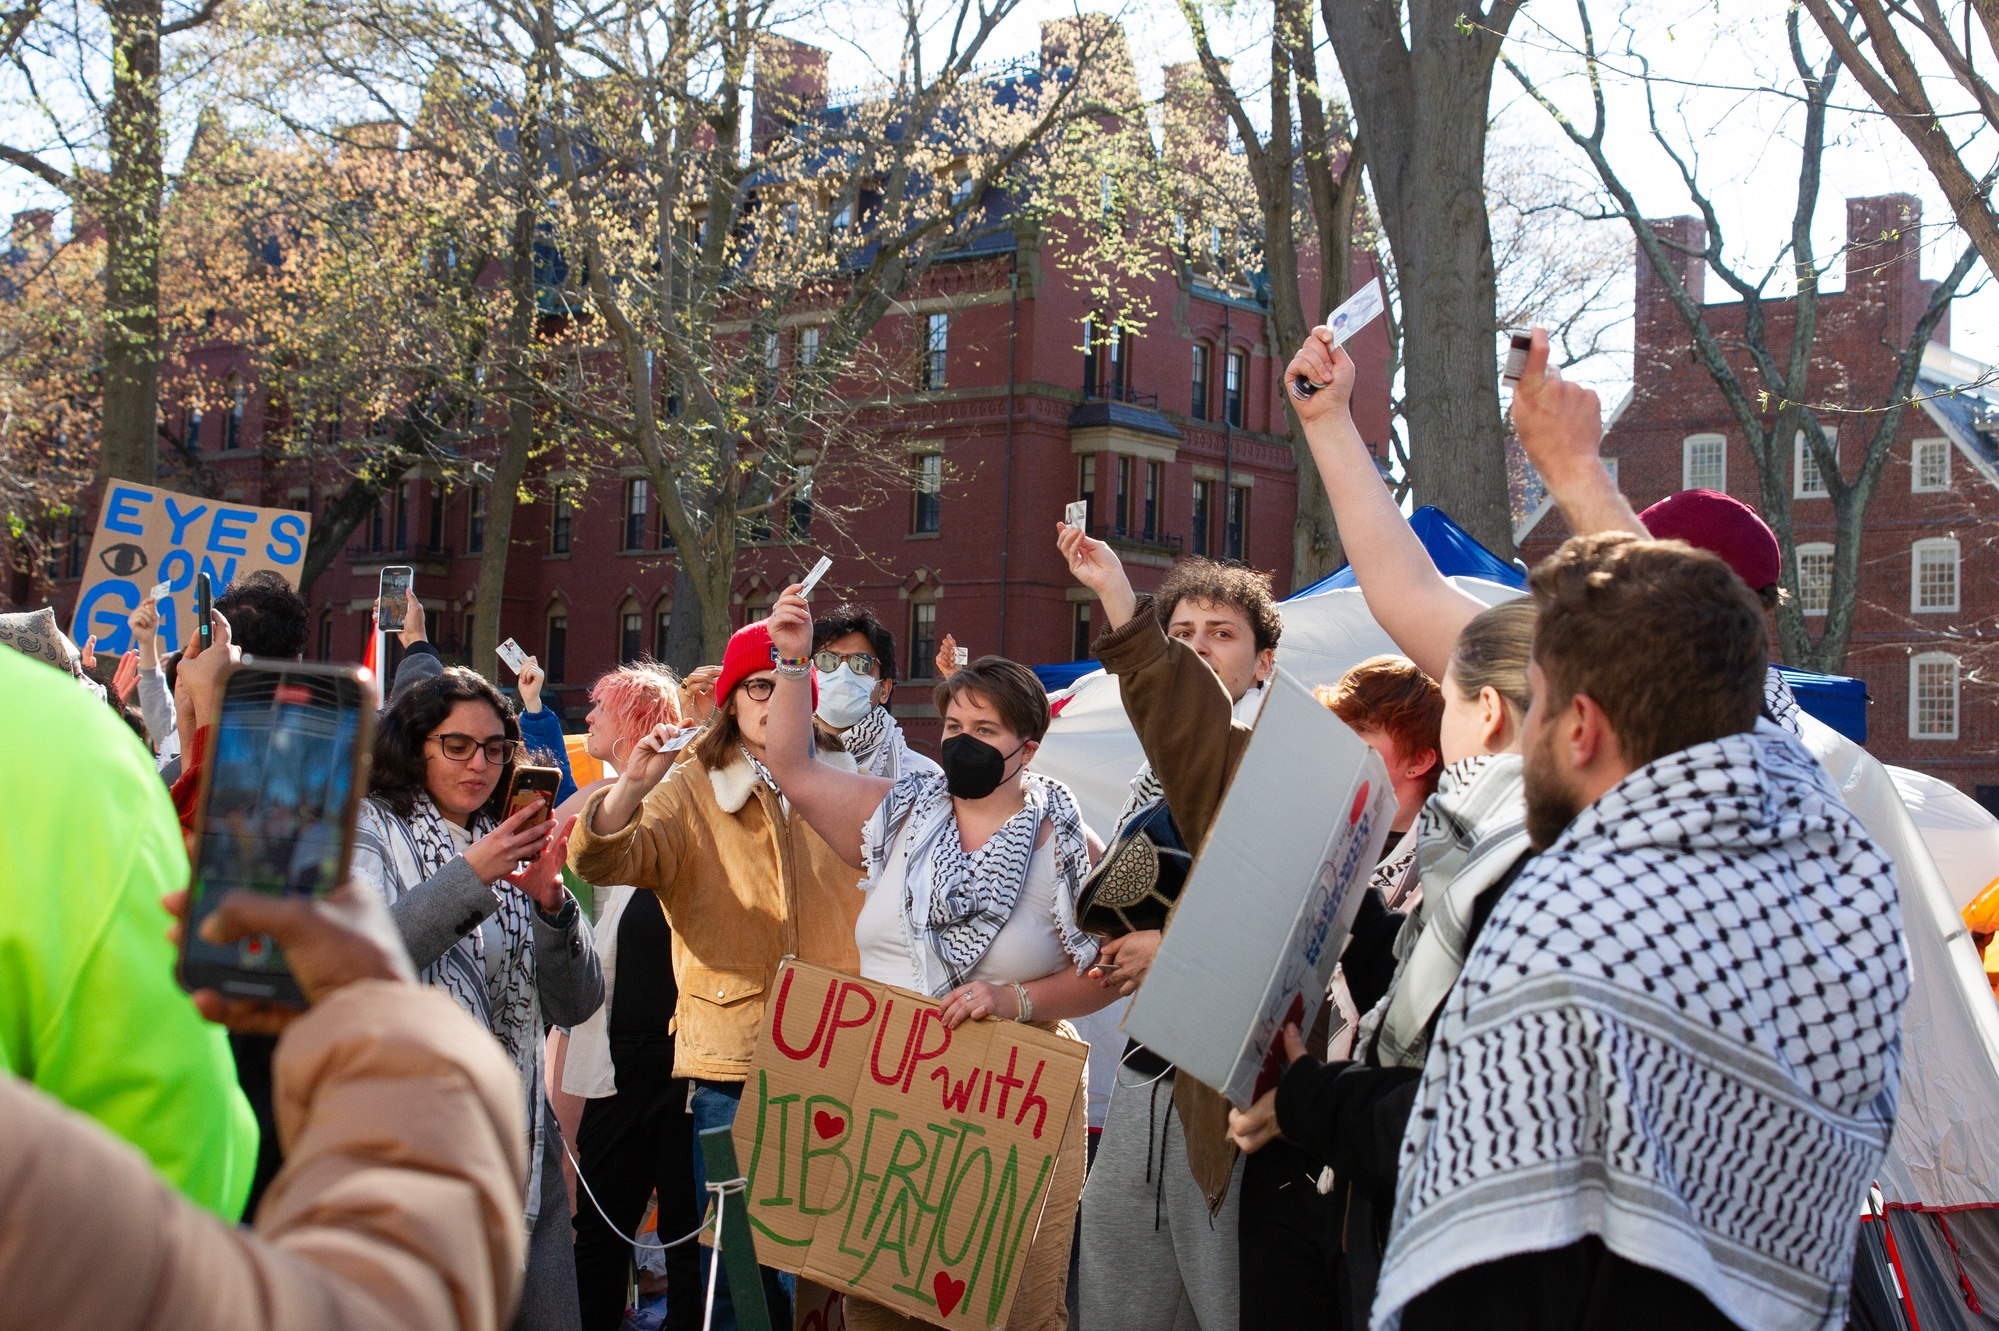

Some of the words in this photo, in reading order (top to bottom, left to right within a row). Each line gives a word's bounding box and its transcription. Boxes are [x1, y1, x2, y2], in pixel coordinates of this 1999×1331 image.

[104, 487, 306, 565] EYES
[157, 549, 237, 601] ON
[772, 967, 877, 1068] UP
[870, 999, 953, 1094] UP
[930, 1046, 1048, 1139] with
